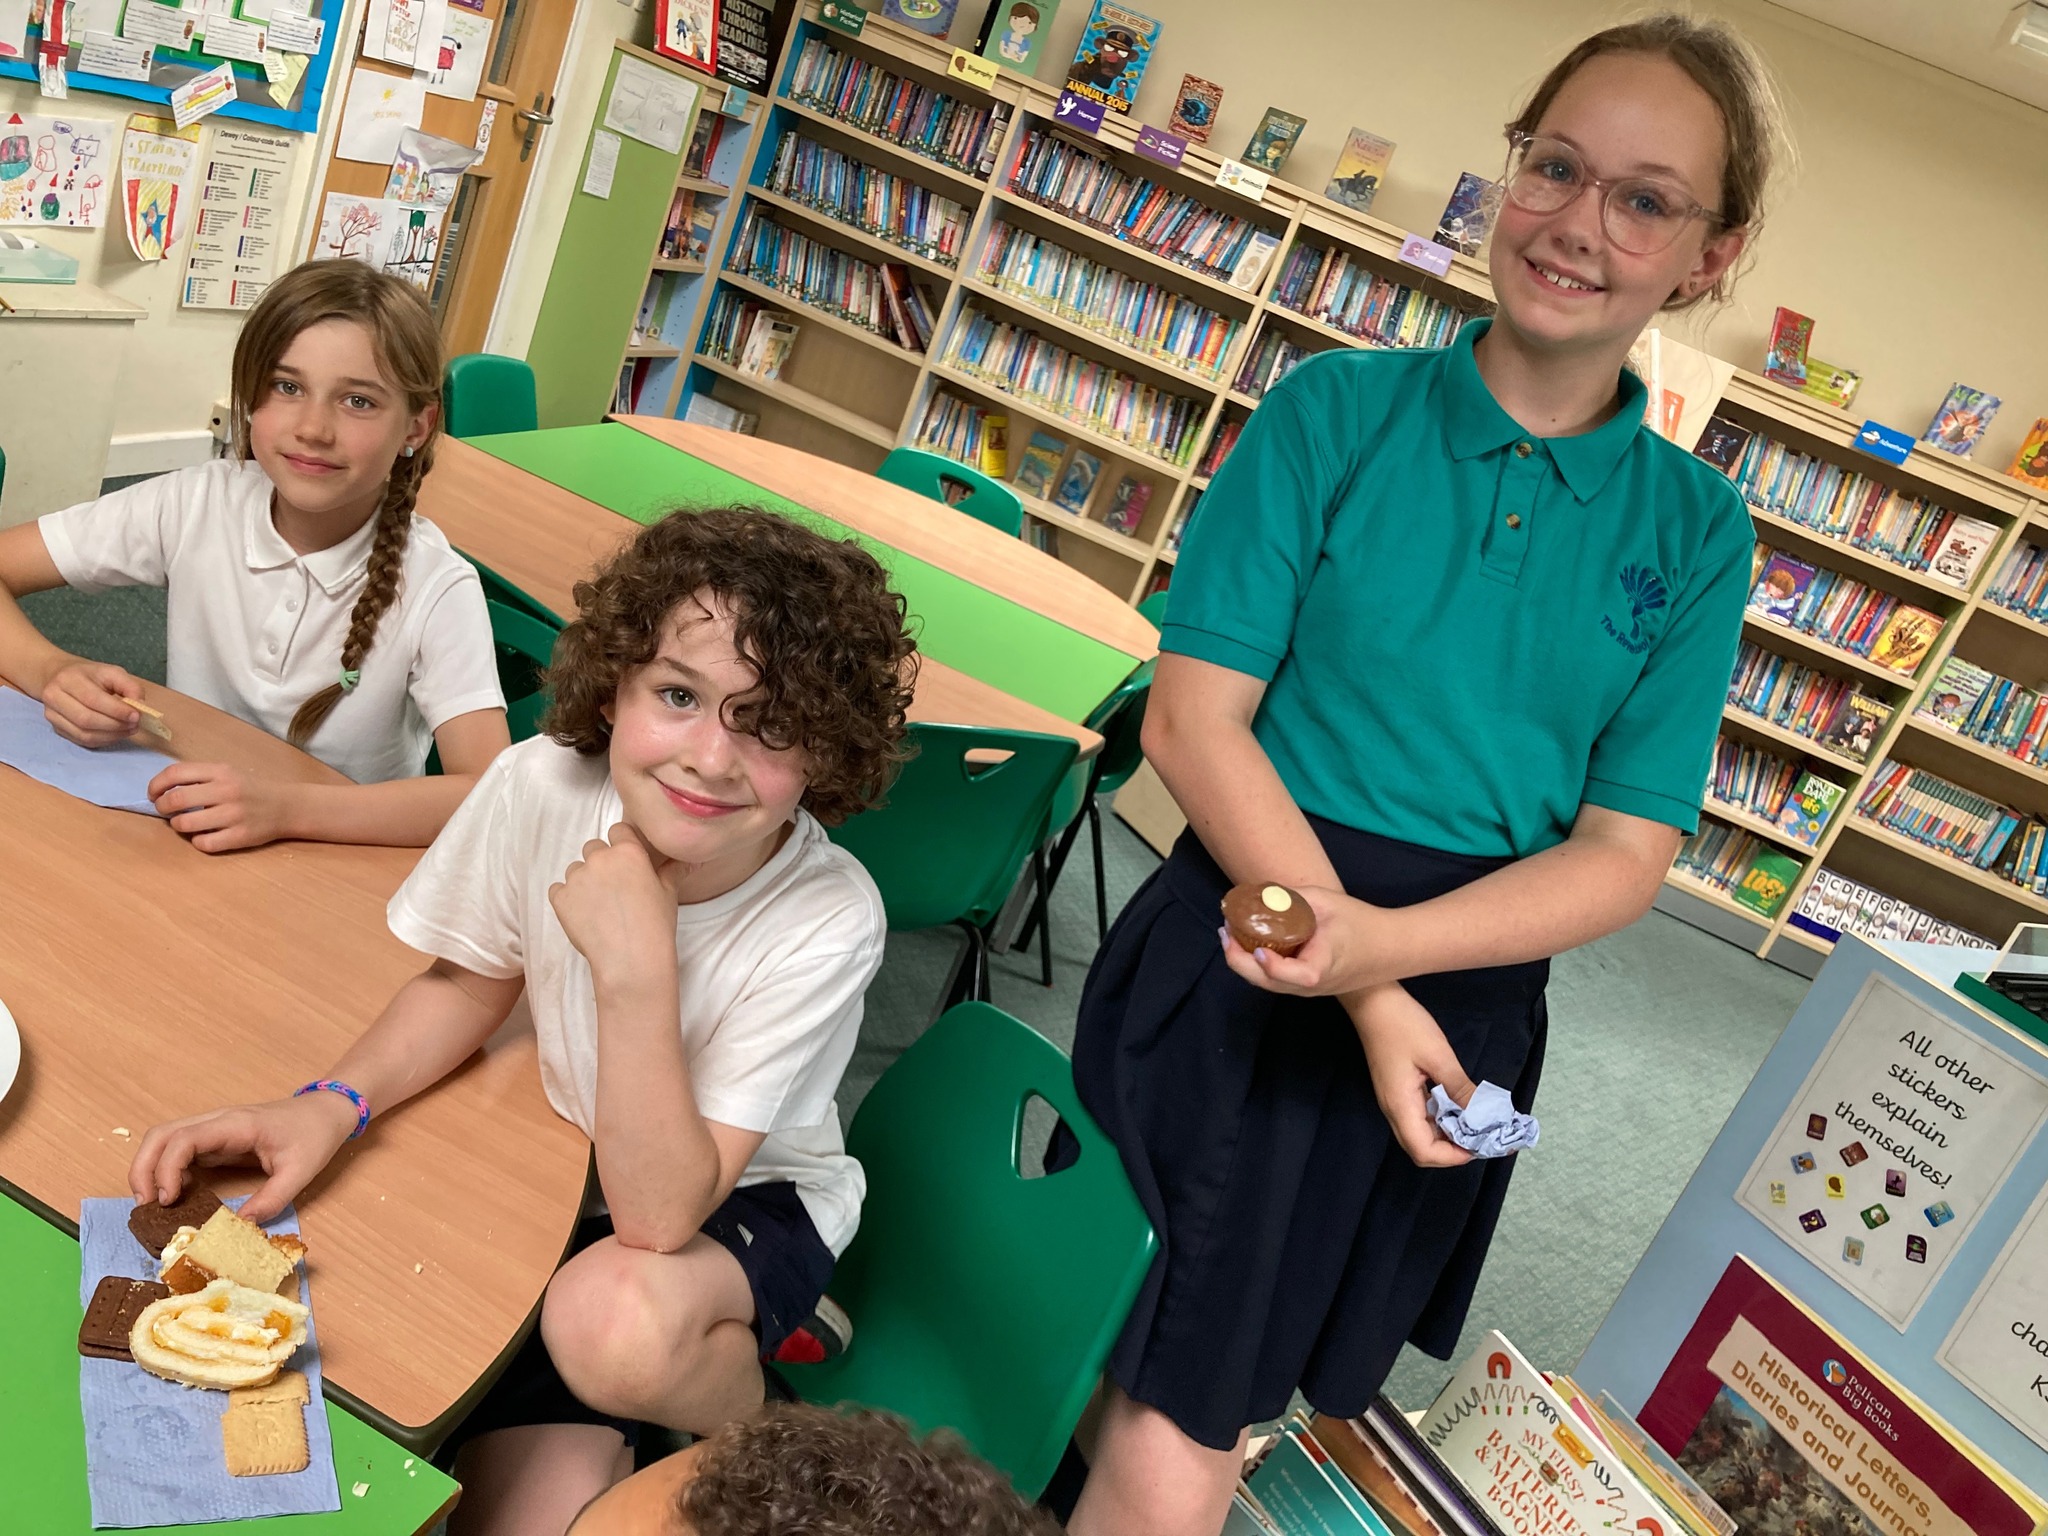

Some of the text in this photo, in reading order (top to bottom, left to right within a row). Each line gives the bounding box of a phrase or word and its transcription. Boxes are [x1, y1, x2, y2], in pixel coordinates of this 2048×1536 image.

[722, 8, 766, 39] THROUGH
[839, 16, 859, 29] Fiction
[967, 63, 993, 80] Biography
[1066, 80, 1105, 103] ANNUAL
[1106, 95, 1129, 112] 2015
[1077, 109, 1098, 122] Horror
[220, 130, 239, 141] Dewey
[242, 133, 275, 146] Colour-code
[1157, 146, 1178, 160] Fiction
[1159, 140, 1180, 153] Science
[1240, 177, 1263, 190] Animals
[1802, 902, 1812, 915] b
[1826, 915, 1838, 926] d
[1817, 872, 1827, 883] B
[1830, 879, 1841, 890] C
[1842, 883, 1852, 894] D
[1855, 889, 1866, 900] E
[1868, 895, 1878, 905] F
[1880, 900, 1891, 912] G
[1893, 903, 1907, 916] H
[1907, 911, 1914, 922] I
[1919, 918, 1929, 928] J
[1932, 924, 1944, 937] K
[1945, 928, 1952, 939] L
[1957, 933, 1970, 947] N
[1899, 1030, 1995, 1095] All other
[1888, 1062, 1967, 1120] stickers
[1872, 1091, 1949, 1150] explain
[1835, 1100, 1954, 1191] themselves!
[1842, 1384, 1900, 1442] Big Books
[1847, 1375, 1893, 1420] Pelican
[1730, 1360, 1799, 1431] Diaries
[1802, 1424, 1845, 1472] and
[1475, 1445, 1490, 1463] &
[1757, 1351, 1934, 1527] Historical Letters,
[1521, 1428, 1586, 1503] MY FIRST
